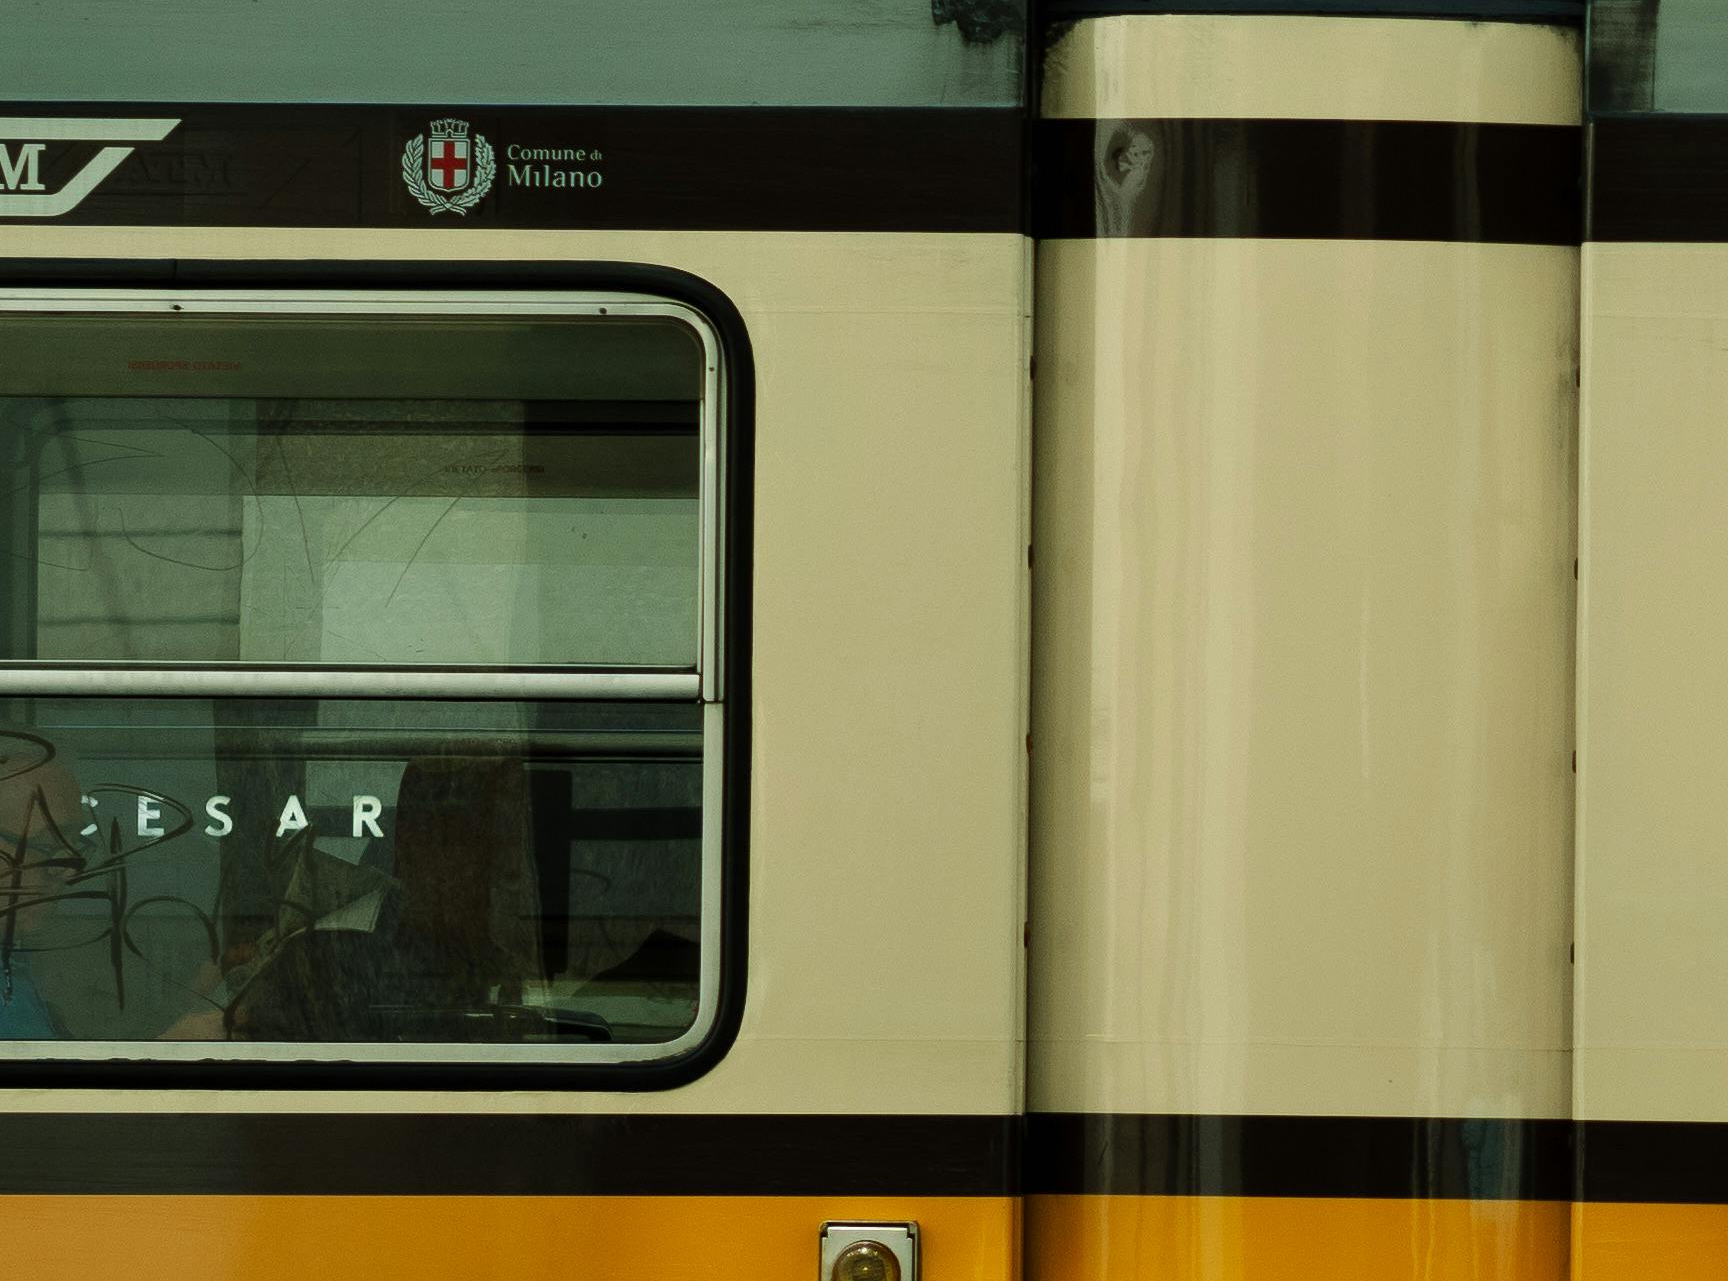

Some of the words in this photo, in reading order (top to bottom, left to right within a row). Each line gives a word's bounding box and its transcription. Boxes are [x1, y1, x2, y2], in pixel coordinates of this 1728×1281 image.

[507, 144, 586, 160] Comune
[590, 149, 602, 161] di
[507, 164, 602, 188] Milano
